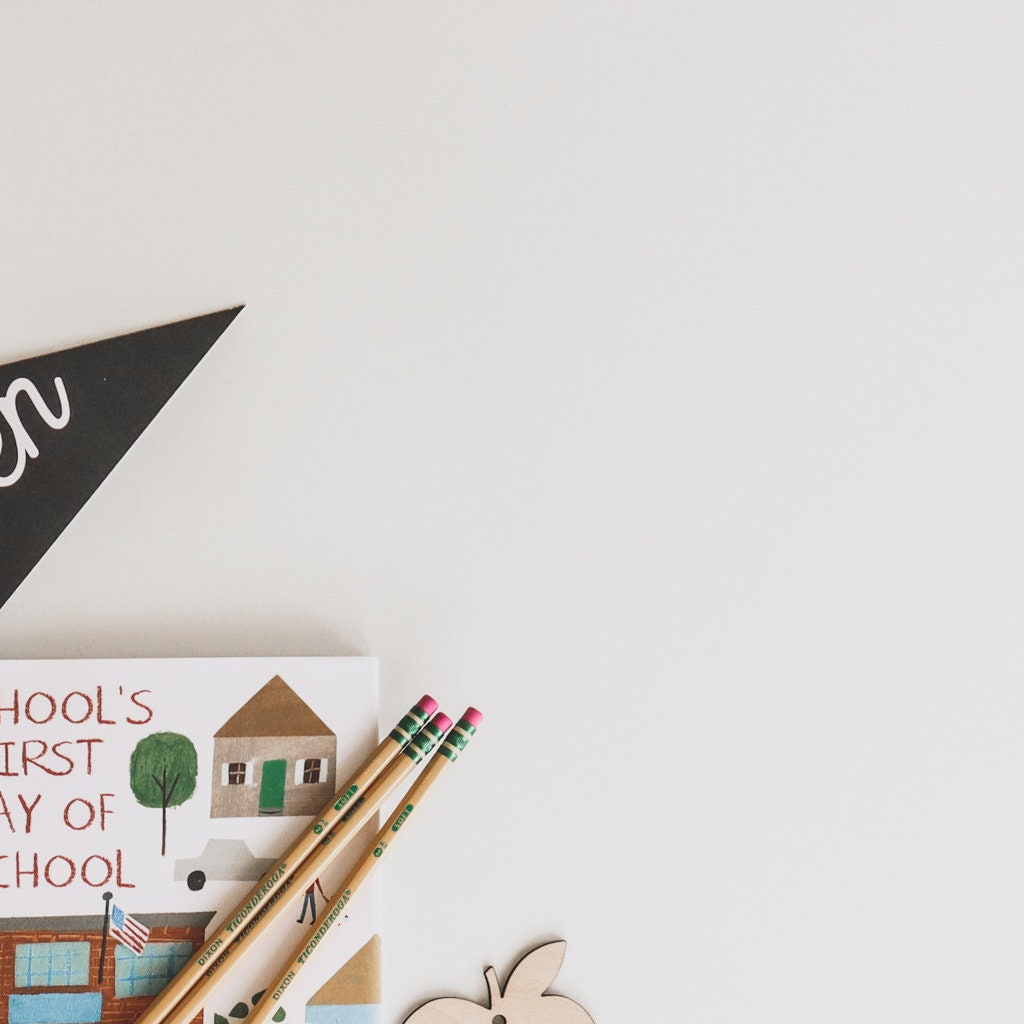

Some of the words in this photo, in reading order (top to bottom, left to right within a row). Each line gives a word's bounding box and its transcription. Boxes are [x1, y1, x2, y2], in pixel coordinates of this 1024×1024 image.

[64, 793, 115, 831] OF
[197, 938, 223, 966] DIXON
[272, 971, 295, 1000] DIXON
